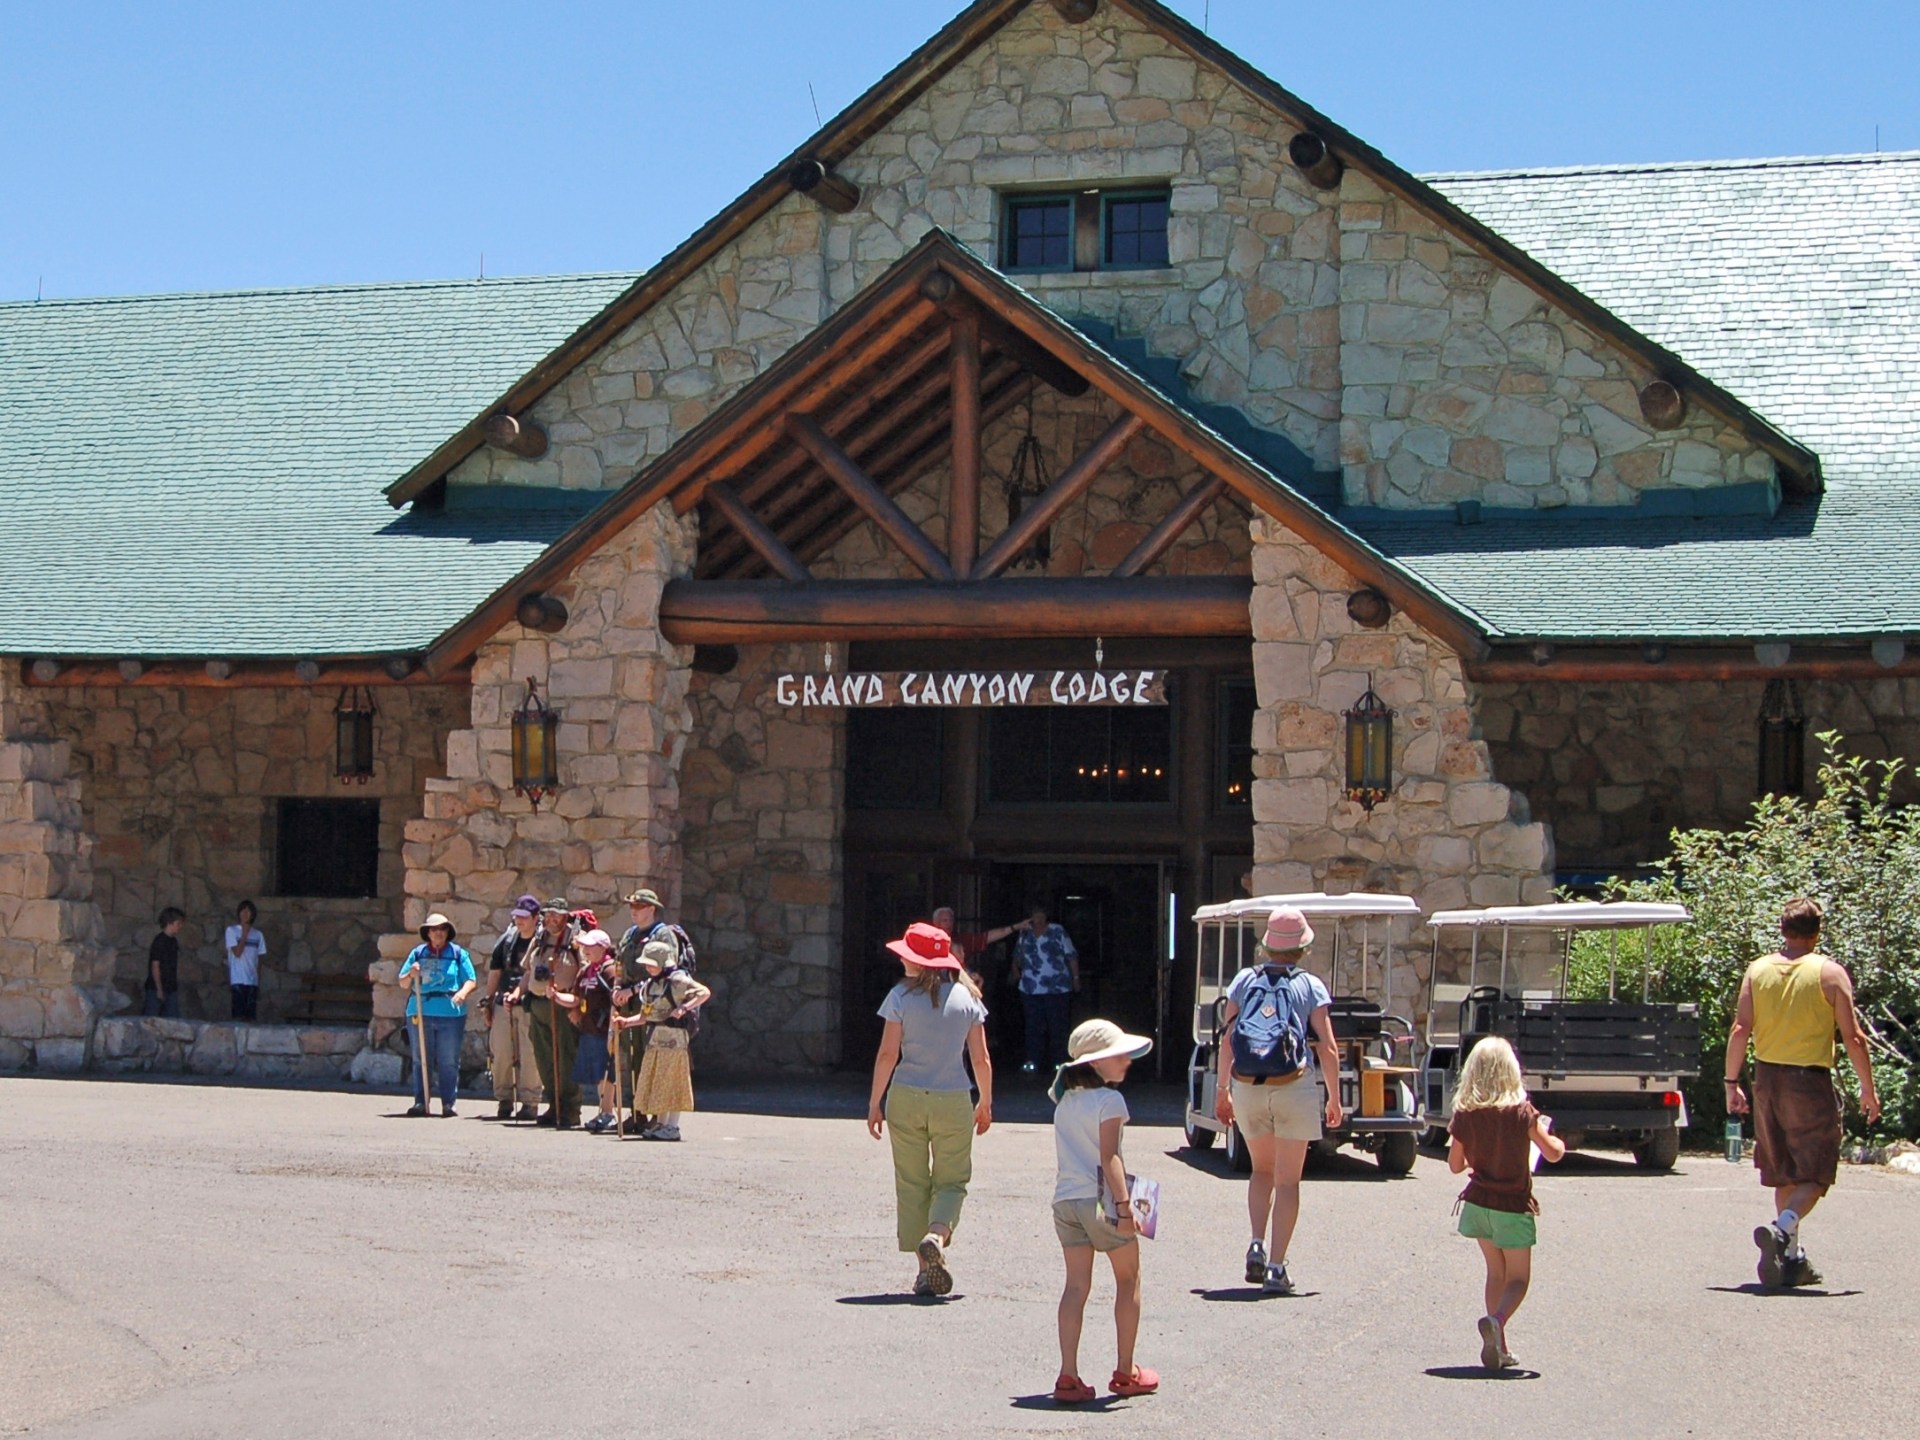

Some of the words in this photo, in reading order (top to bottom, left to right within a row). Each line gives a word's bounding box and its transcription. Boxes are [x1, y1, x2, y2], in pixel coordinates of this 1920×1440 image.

[777, 674, 884, 706] GRAND
[900, 672, 1035, 705] CANYON
[1050, 671, 1154, 704] LODGE
